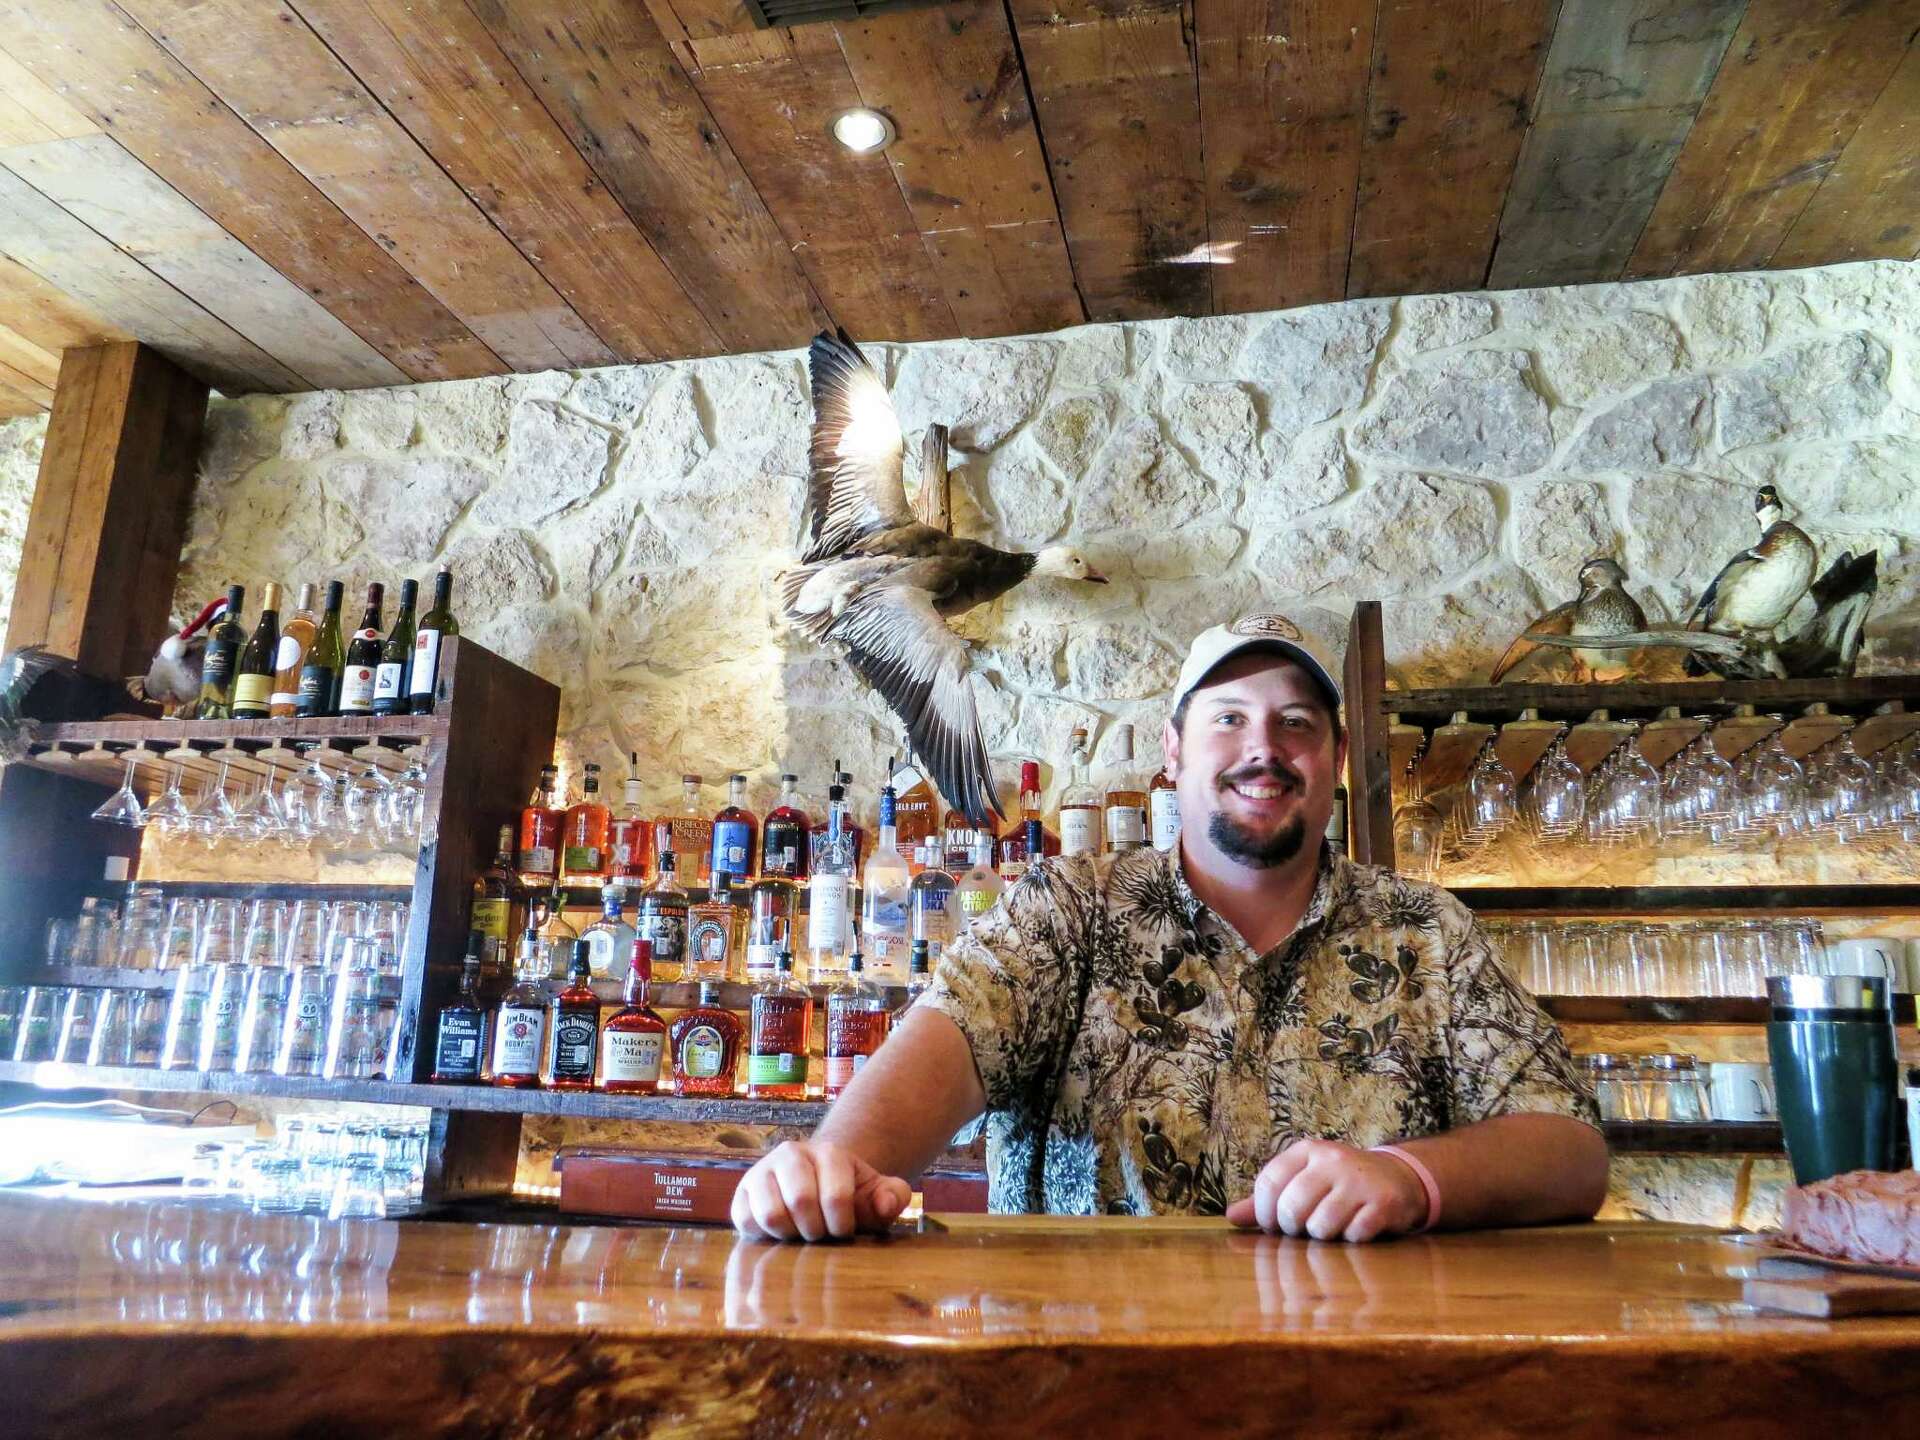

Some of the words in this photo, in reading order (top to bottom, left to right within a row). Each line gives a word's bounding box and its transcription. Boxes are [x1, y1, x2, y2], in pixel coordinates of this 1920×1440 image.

[448, 1018, 471, 1026] Evan
[505, 1014, 518, 1025] JIM
[519, 1013, 538, 1028] BEAM
[556, 1020, 571, 1031] JACK
[440, 1025, 477, 1035] Williams
[611, 1037, 659, 1047] Maker's
[654, 1172, 697, 1187] TULLAMORE
[665, 1185, 684, 1196] DEW
